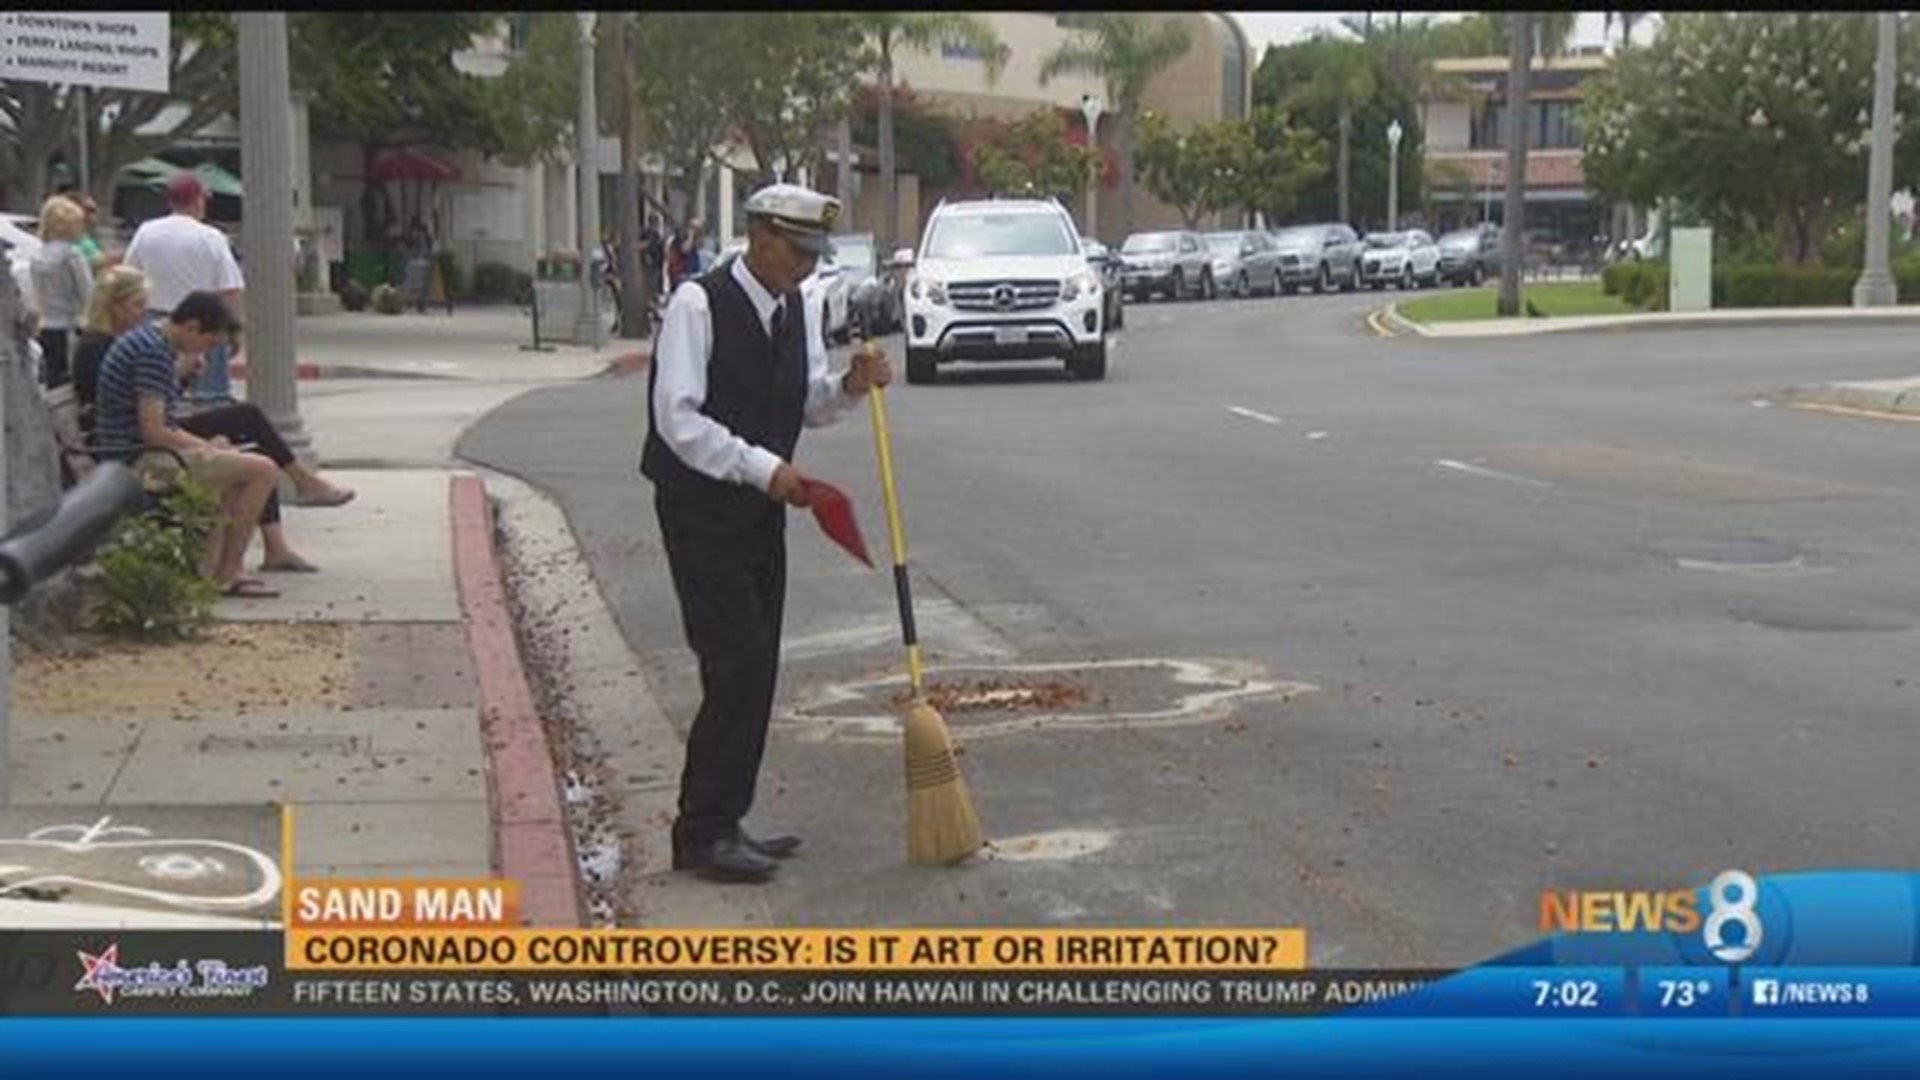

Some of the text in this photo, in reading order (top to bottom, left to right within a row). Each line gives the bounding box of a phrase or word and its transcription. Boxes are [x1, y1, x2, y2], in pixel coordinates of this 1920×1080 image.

[17, 15, 137, 36] DOWNTOWN SHOPS
[17, 36, 56, 49] FERRY
[17, 56, 129, 74] MARRIOTT RESORT
